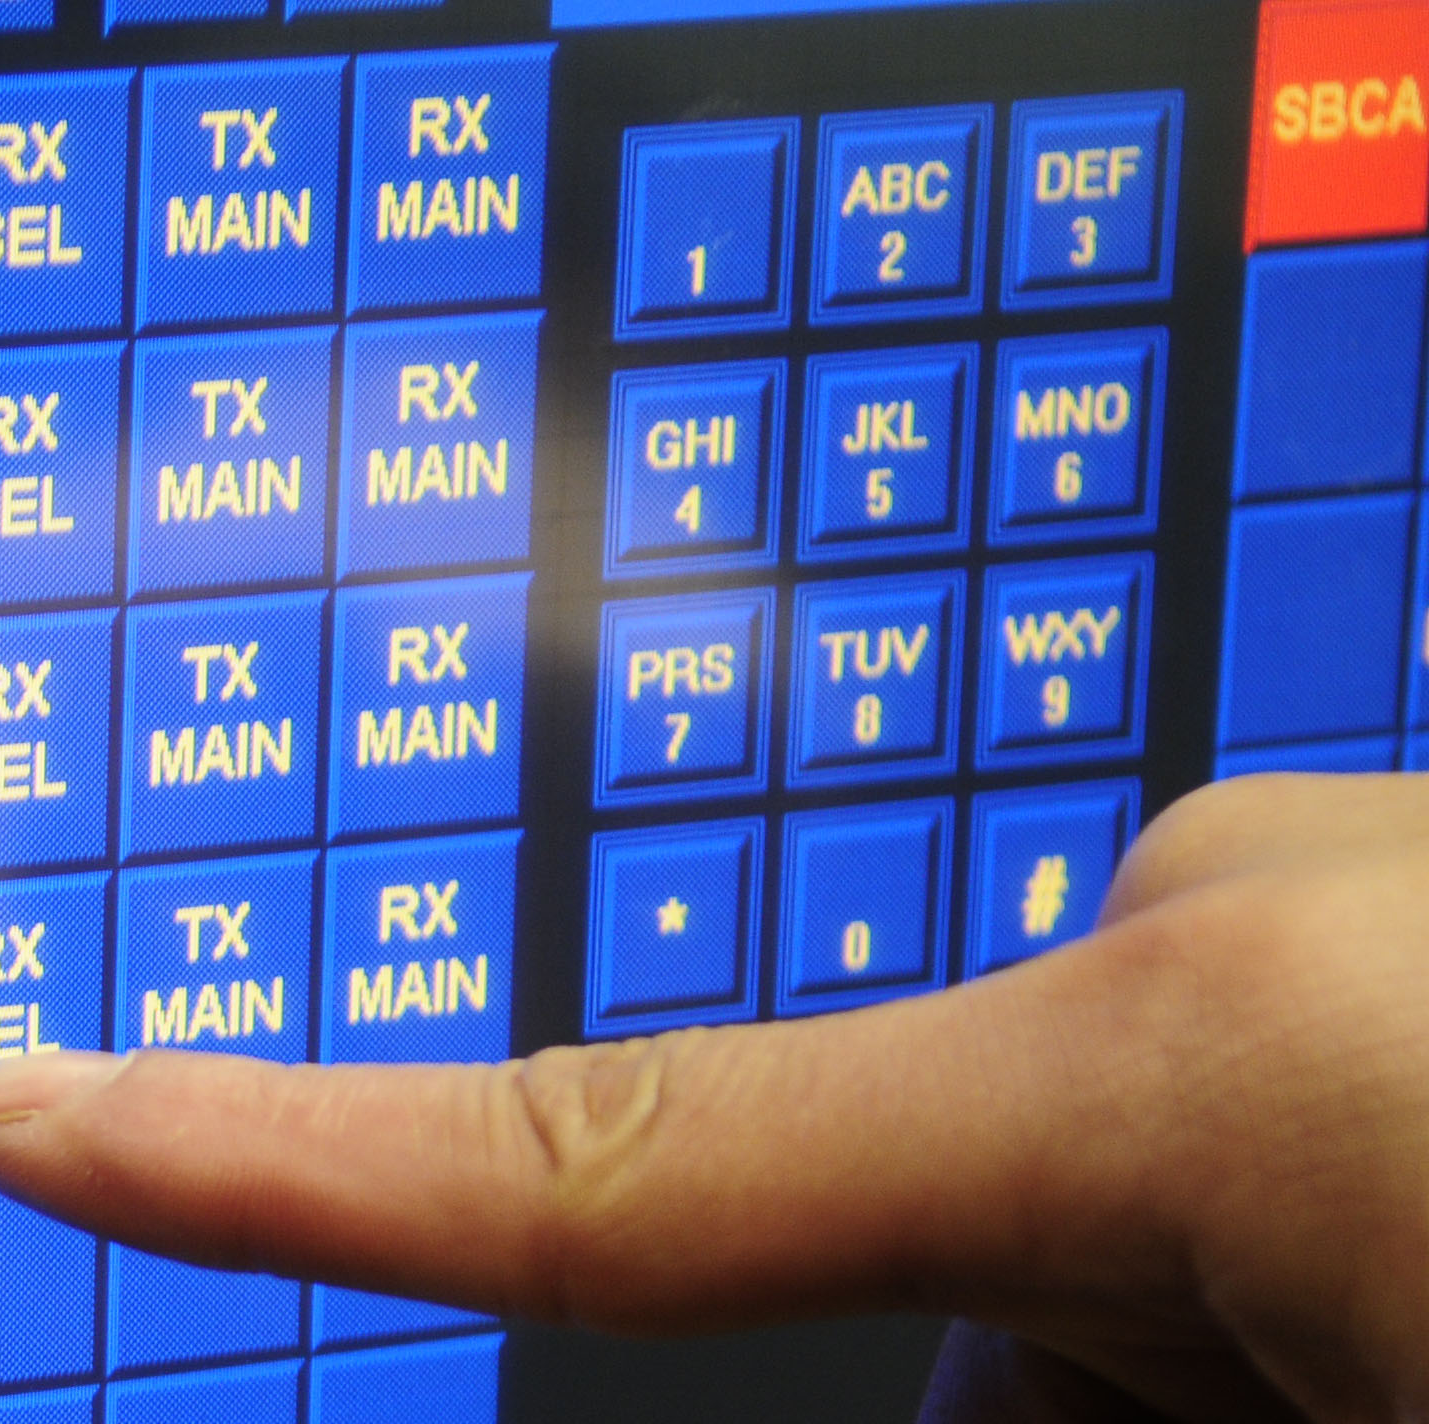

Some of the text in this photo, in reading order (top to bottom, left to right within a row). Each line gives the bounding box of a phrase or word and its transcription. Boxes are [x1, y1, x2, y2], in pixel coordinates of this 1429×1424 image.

[199, 106, 279, 172] TX
[408, 93, 492, 159] RX
[1272, 74, 1426, 146] SBCA
[840, 160, 950, 217] ABC
[1035, 146, 1140, 203] DEF
[165, 188, 312, 258] MAIN
[376, 173, 520, 242] MAIN
[685, 245, 707, 297] 1
[878, 230, 907, 283] 2
[1069, 216, 1098, 268] 3
[189, 375, 269, 441] TX
[396, 359, 480, 426] RX
[1014, 382, 1131, 440] MNO
[643, 414, 736, 473] GHI
[841, 400, 928, 455] JKL
[155, 454, 303, 526] MAIN
[364, 437, 509, 510] MAIN
[865, 468, 893, 520] 5
[1053, 451, 1082, 503] 6
[672, 484, 703, 537] 4
[387, 621, 470, 687] RX
[818, 624, 929, 682] TUV
[1003, 605, 1121, 664] WXY
[181, 640, 260, 704] TX
[627, 641, 735, 702] PRS
[1042, 675, 1071, 727] 9
[355, 698, 498, 769] MAIN
[663, 712, 692, 765] 7
[853, 694, 883, 746] 8
[148, 717, 293, 789] MAIN
[173, 900, 252, 964] TX
[378, 878, 460, 944] RX
[841, 920, 872, 972] 0
[141, 975, 284, 1046] MAIN
[347, 954, 488, 1026] MAIN
